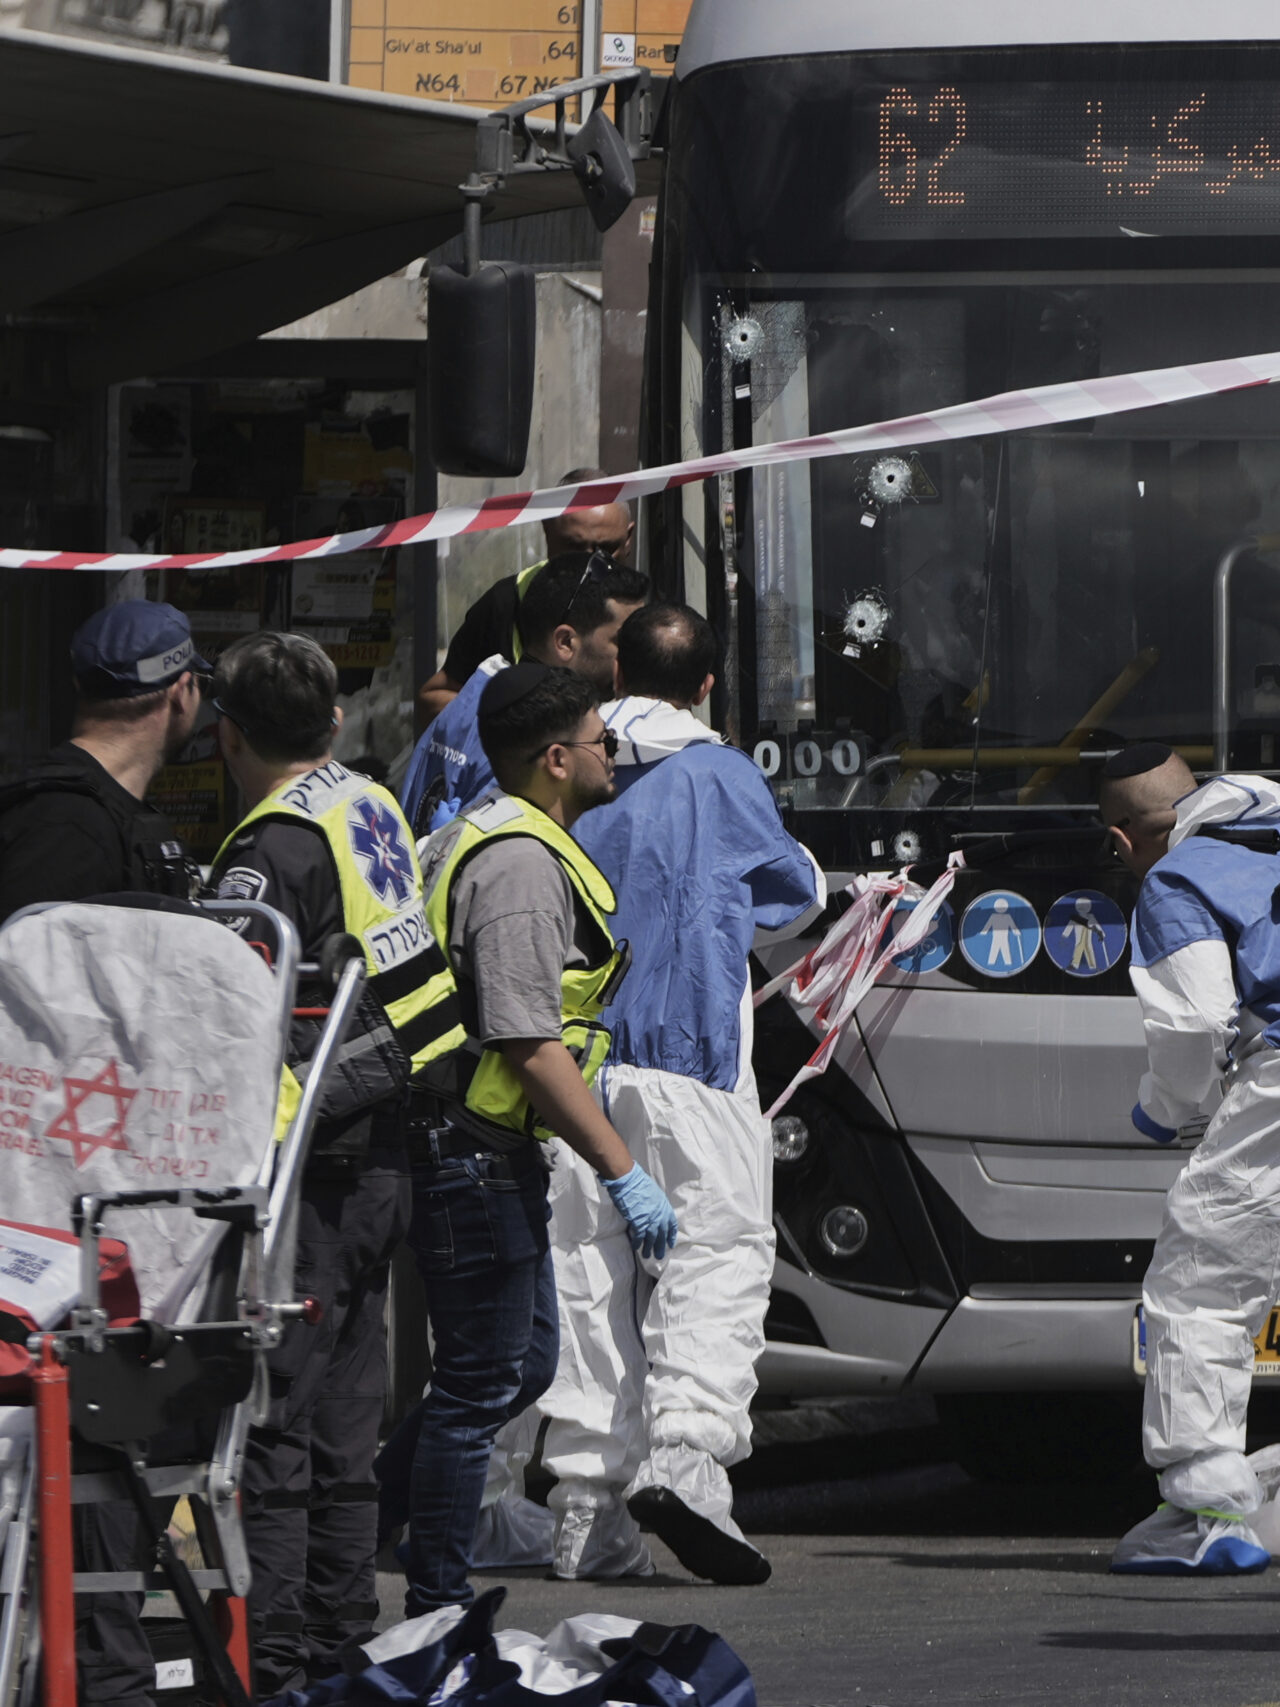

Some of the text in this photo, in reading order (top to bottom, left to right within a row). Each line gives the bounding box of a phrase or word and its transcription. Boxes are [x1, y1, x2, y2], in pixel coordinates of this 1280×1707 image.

[557, 6, 578, 25] 61
[385, 39, 431, 55] Giv'at
[435, 39, 482, 55] Sha'ul
[879, 87, 967, 204] 62
[162, 640, 193, 670] POLI
[282, 762, 352, 813] מדיק
[371, 909, 430, 965] שטרה
[0, 1061, 54, 1092] AGEN
[144, 1087, 183, 1108] דוד
[9, 1262, 42, 1279] DAVID
